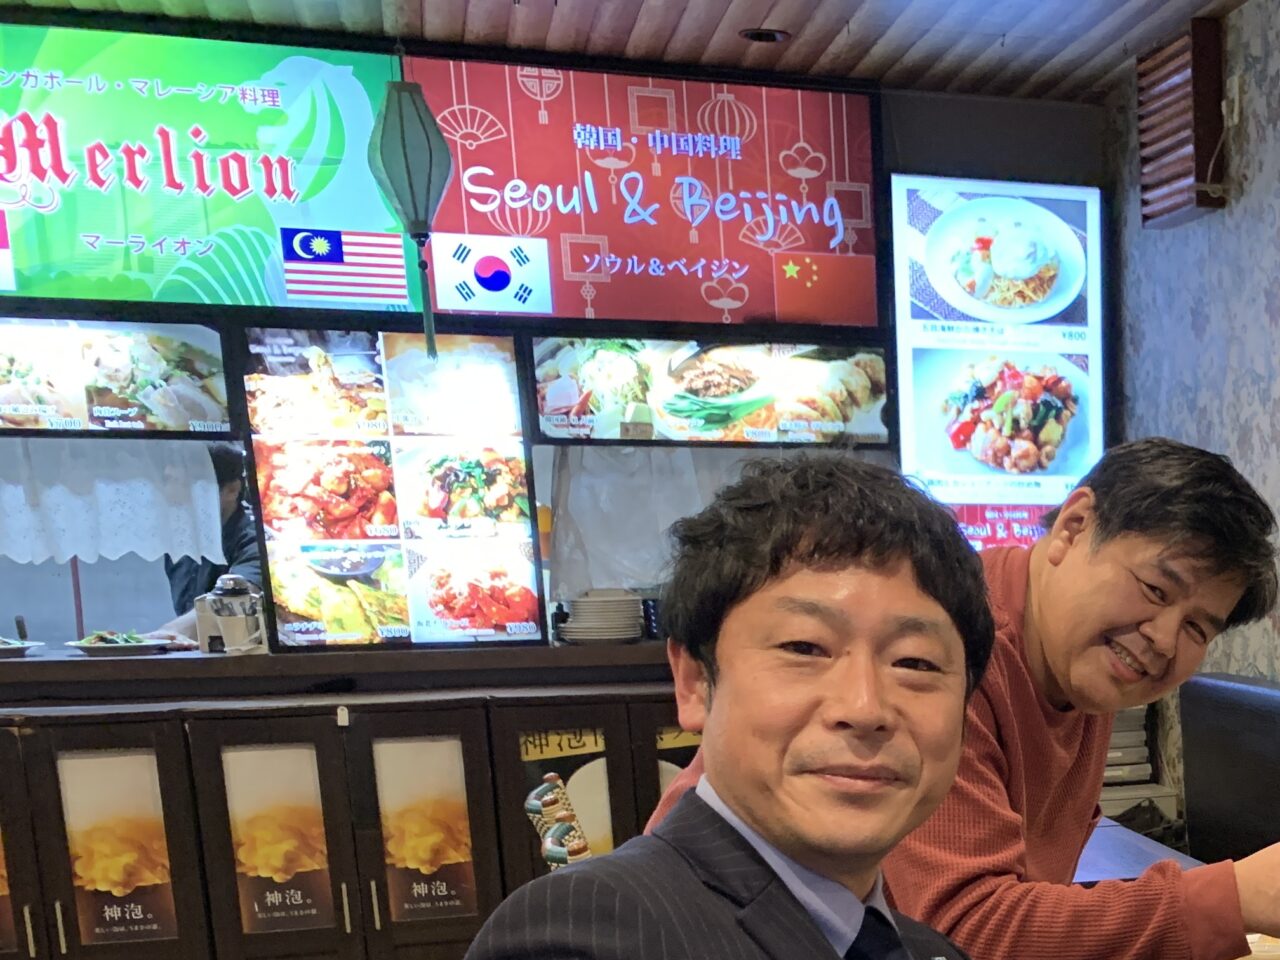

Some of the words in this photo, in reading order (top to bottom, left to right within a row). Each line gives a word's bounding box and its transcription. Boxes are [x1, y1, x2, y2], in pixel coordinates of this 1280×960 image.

[573, 123, 743, 160] 韓国・中国料理
[462, 166, 597, 215] Seoul
[619, 171, 660, 226] &
[674, 174, 845, 249] Beijing
[81, 233, 215, 257] マーライオン
[582, 253, 750, 280] ソウル&ベイジン
